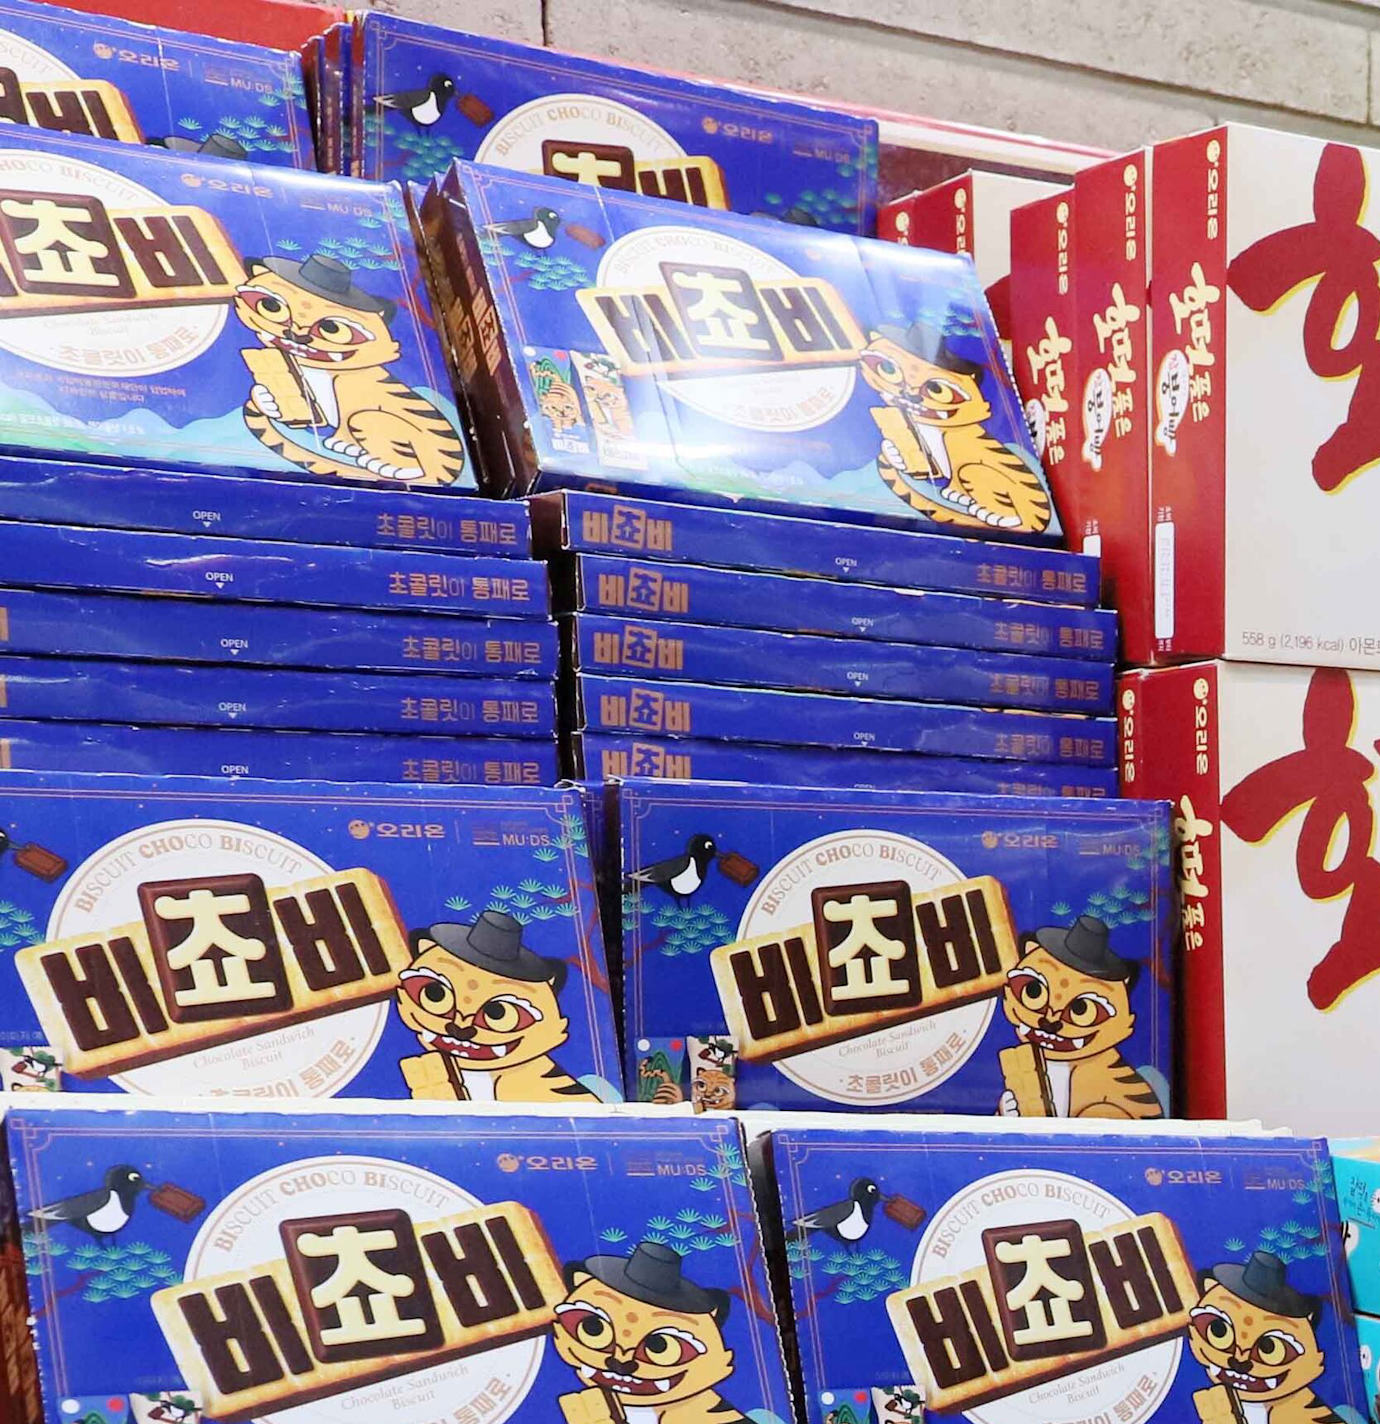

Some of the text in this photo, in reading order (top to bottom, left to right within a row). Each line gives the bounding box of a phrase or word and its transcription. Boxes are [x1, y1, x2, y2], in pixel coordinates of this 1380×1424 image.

[1125, 190, 1137, 262] 오리온
[1207, 168, 1219, 240] 오리온
[0, 196, 228, 298] 쵸비
[595, 271, 853, 363] 비쵸비
[193, 510, 221, 522] OPEN
[376, 513, 517, 546] 초콜릿이 통째로
[582, 505, 672, 551] 비쵸비
[205, 571, 234, 583] OPEN
[390, 570, 529, 601] 초콜릿이 통째로
[599, 567, 689, 613] 비쵸비
[403, 636, 542, 664] 초콜릿이 통째로
[593, 625, 683, 670] 비쵸비
[1242, 632, 1265, 647] 558
[601, 689, 690, 733] 비쵸비
[377, 821, 446, 840] 오리온
[1004, 834, 1058, 850] 오리온
[75, 832, 304, 914] BISCUIT CHOCO BISCUIT
[762, 843, 945, 918] BISCUIT CHOCO BISCUIT
[40, 880, 391, 1051] 비쵸비
[729, 889, 1001, 1040] 비쵸비
[846, 1033, 967, 1094] 초콜릿이 통째로
[525, 1153, 598, 1172] 오리온
[1169, 1169, 1223, 1185] 오리온
[213, 1166, 450, 1253] BISCUIT CHOCO BISCUIT
[931, 1184, 1112, 1260] BISCUIT CHOCO BISCUIT
[178, 1217, 546, 1396] 비쵸비
[907, 1226, 1183, 1388] 비쵸비
[1115, 1377, 1156, 1423] 통째로
